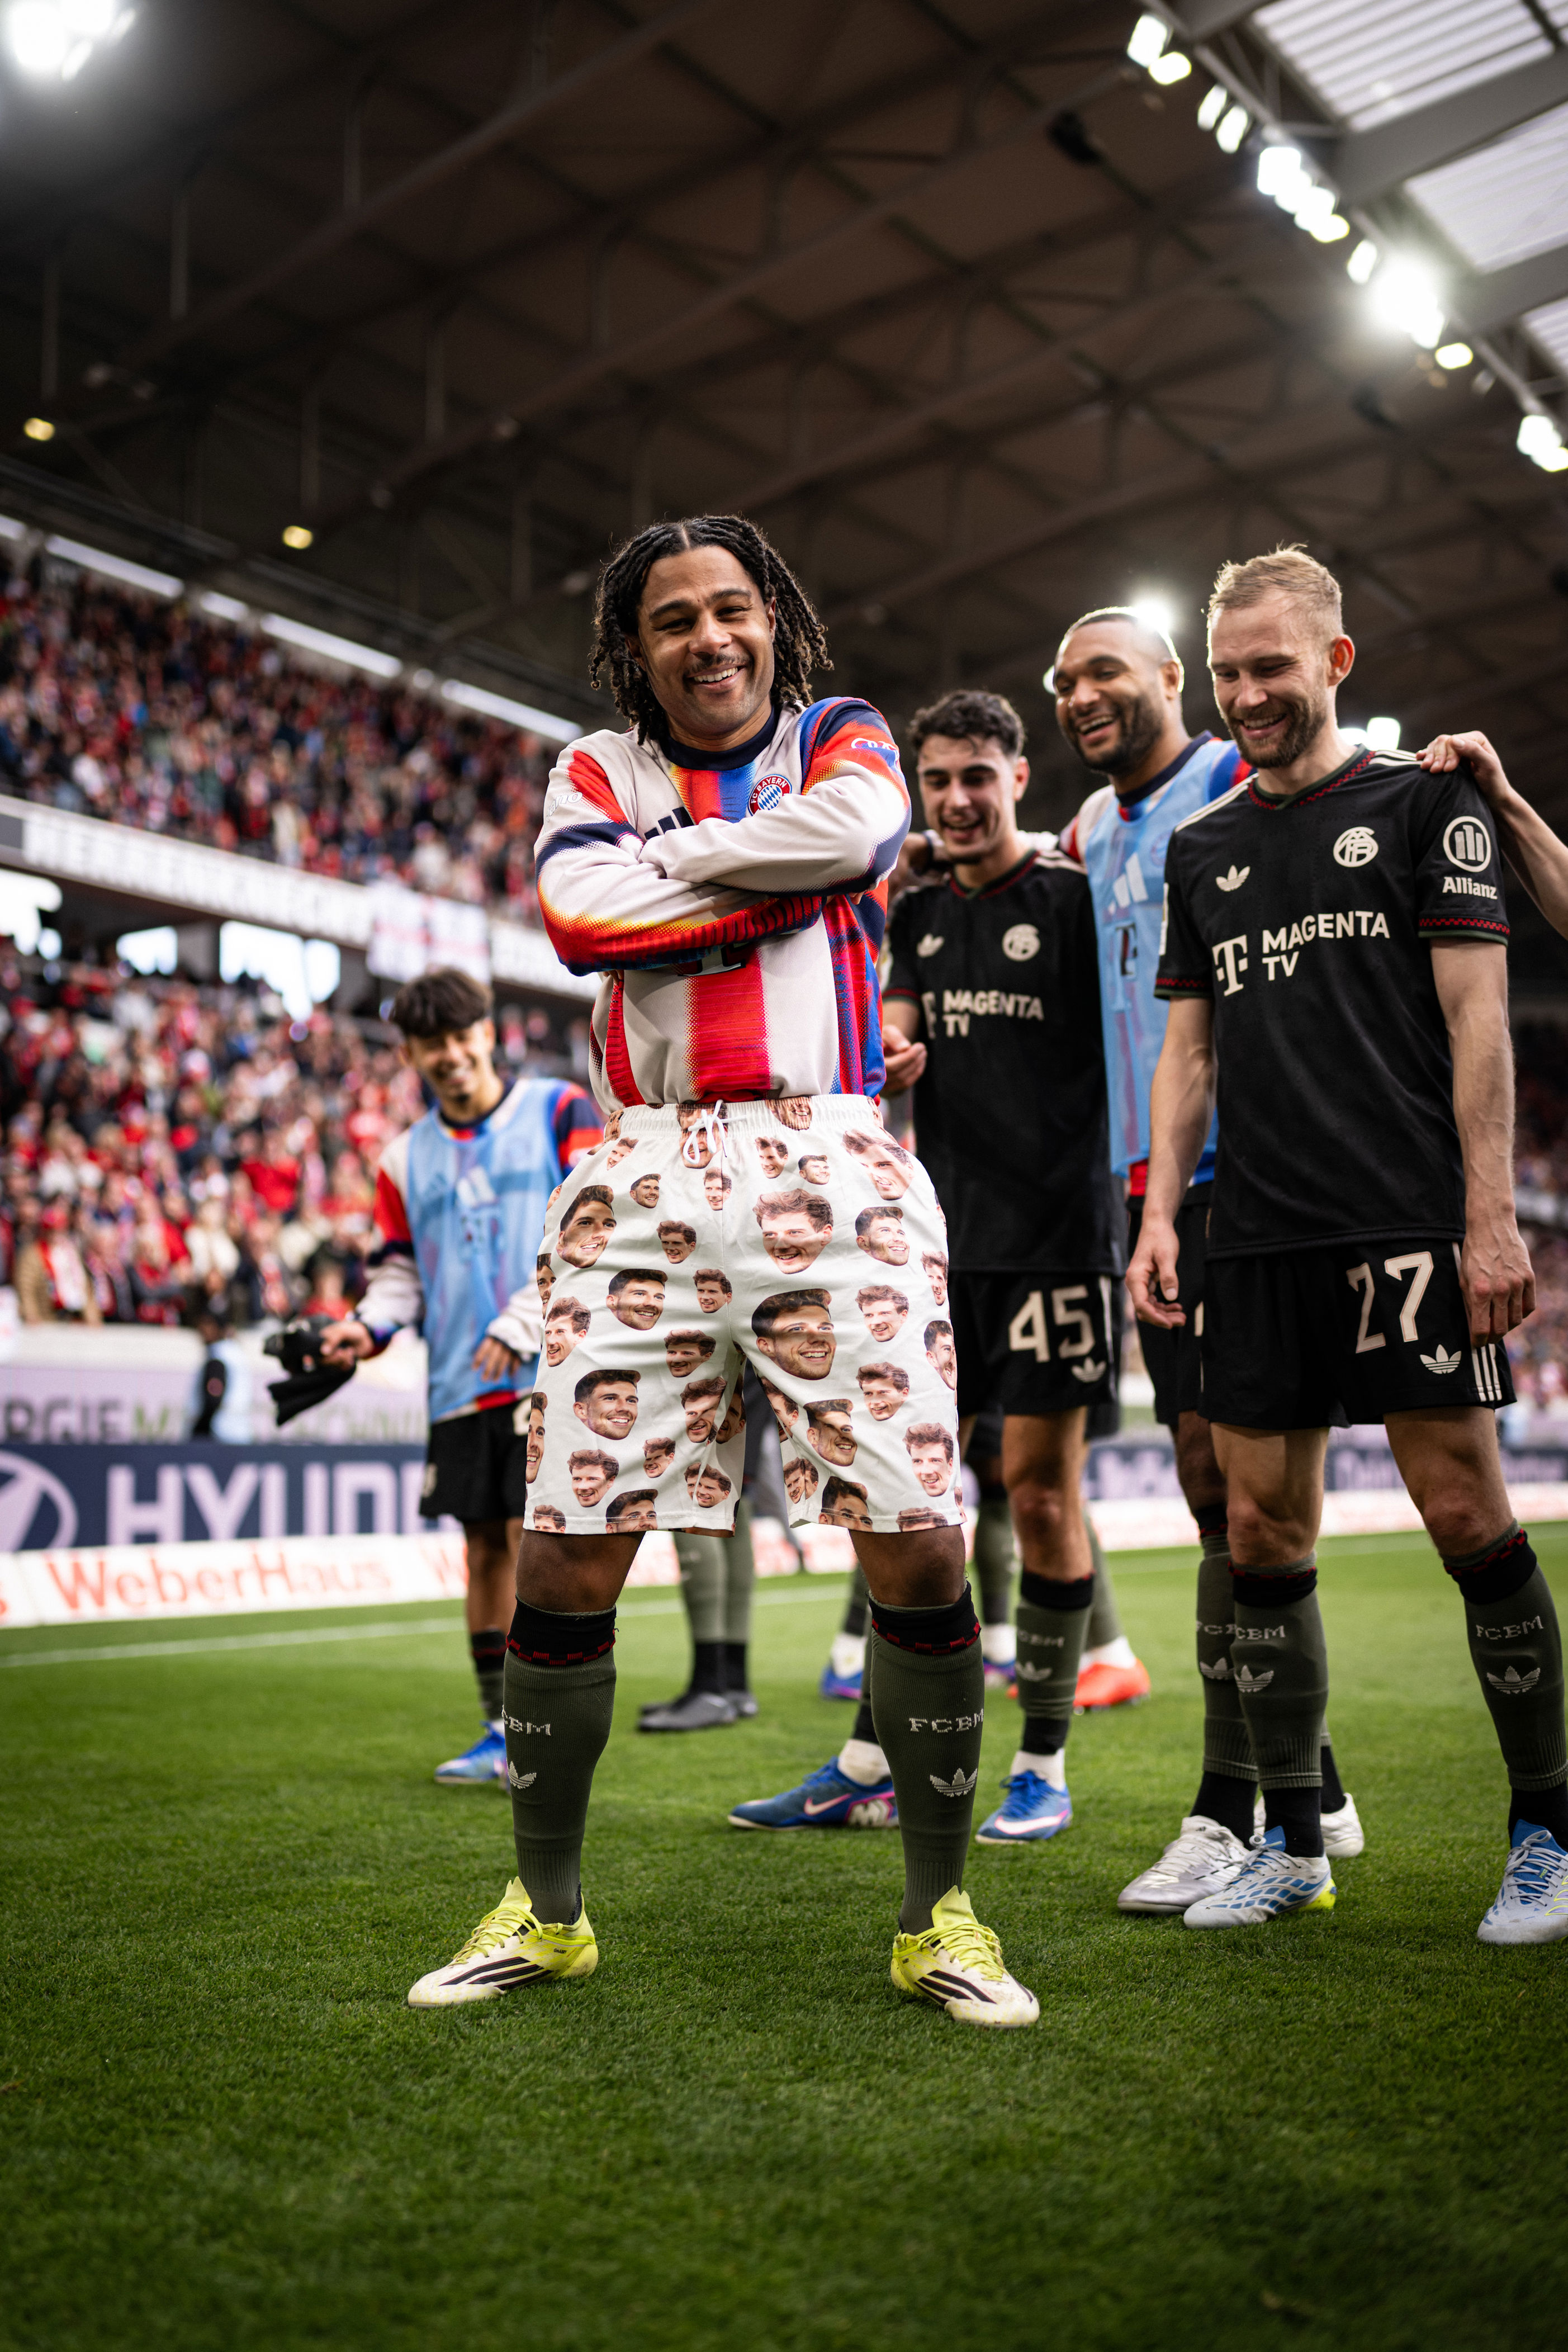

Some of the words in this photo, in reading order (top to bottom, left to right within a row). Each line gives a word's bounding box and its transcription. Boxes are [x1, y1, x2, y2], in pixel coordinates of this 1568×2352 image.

[750, 792, 758, 804] FC
[756, 777, 788, 792] BAYERN
[1442, 876, 1498, 900] Allianz
[1262, 910, 1390, 954] MAGENTA
[1262, 950, 1300, 981] TV
[942, 989, 1044, 1021] MAGENTA
[942, 1012, 970, 1038] TV
[1346, 1250, 1435, 1354] 27
[1008, 1284, 1096, 1363] 45
[1476, 1615, 1545, 1640] FCBM
[501, 1704, 552, 1736] CBM
[908, 1707, 984, 1734] FCBM
